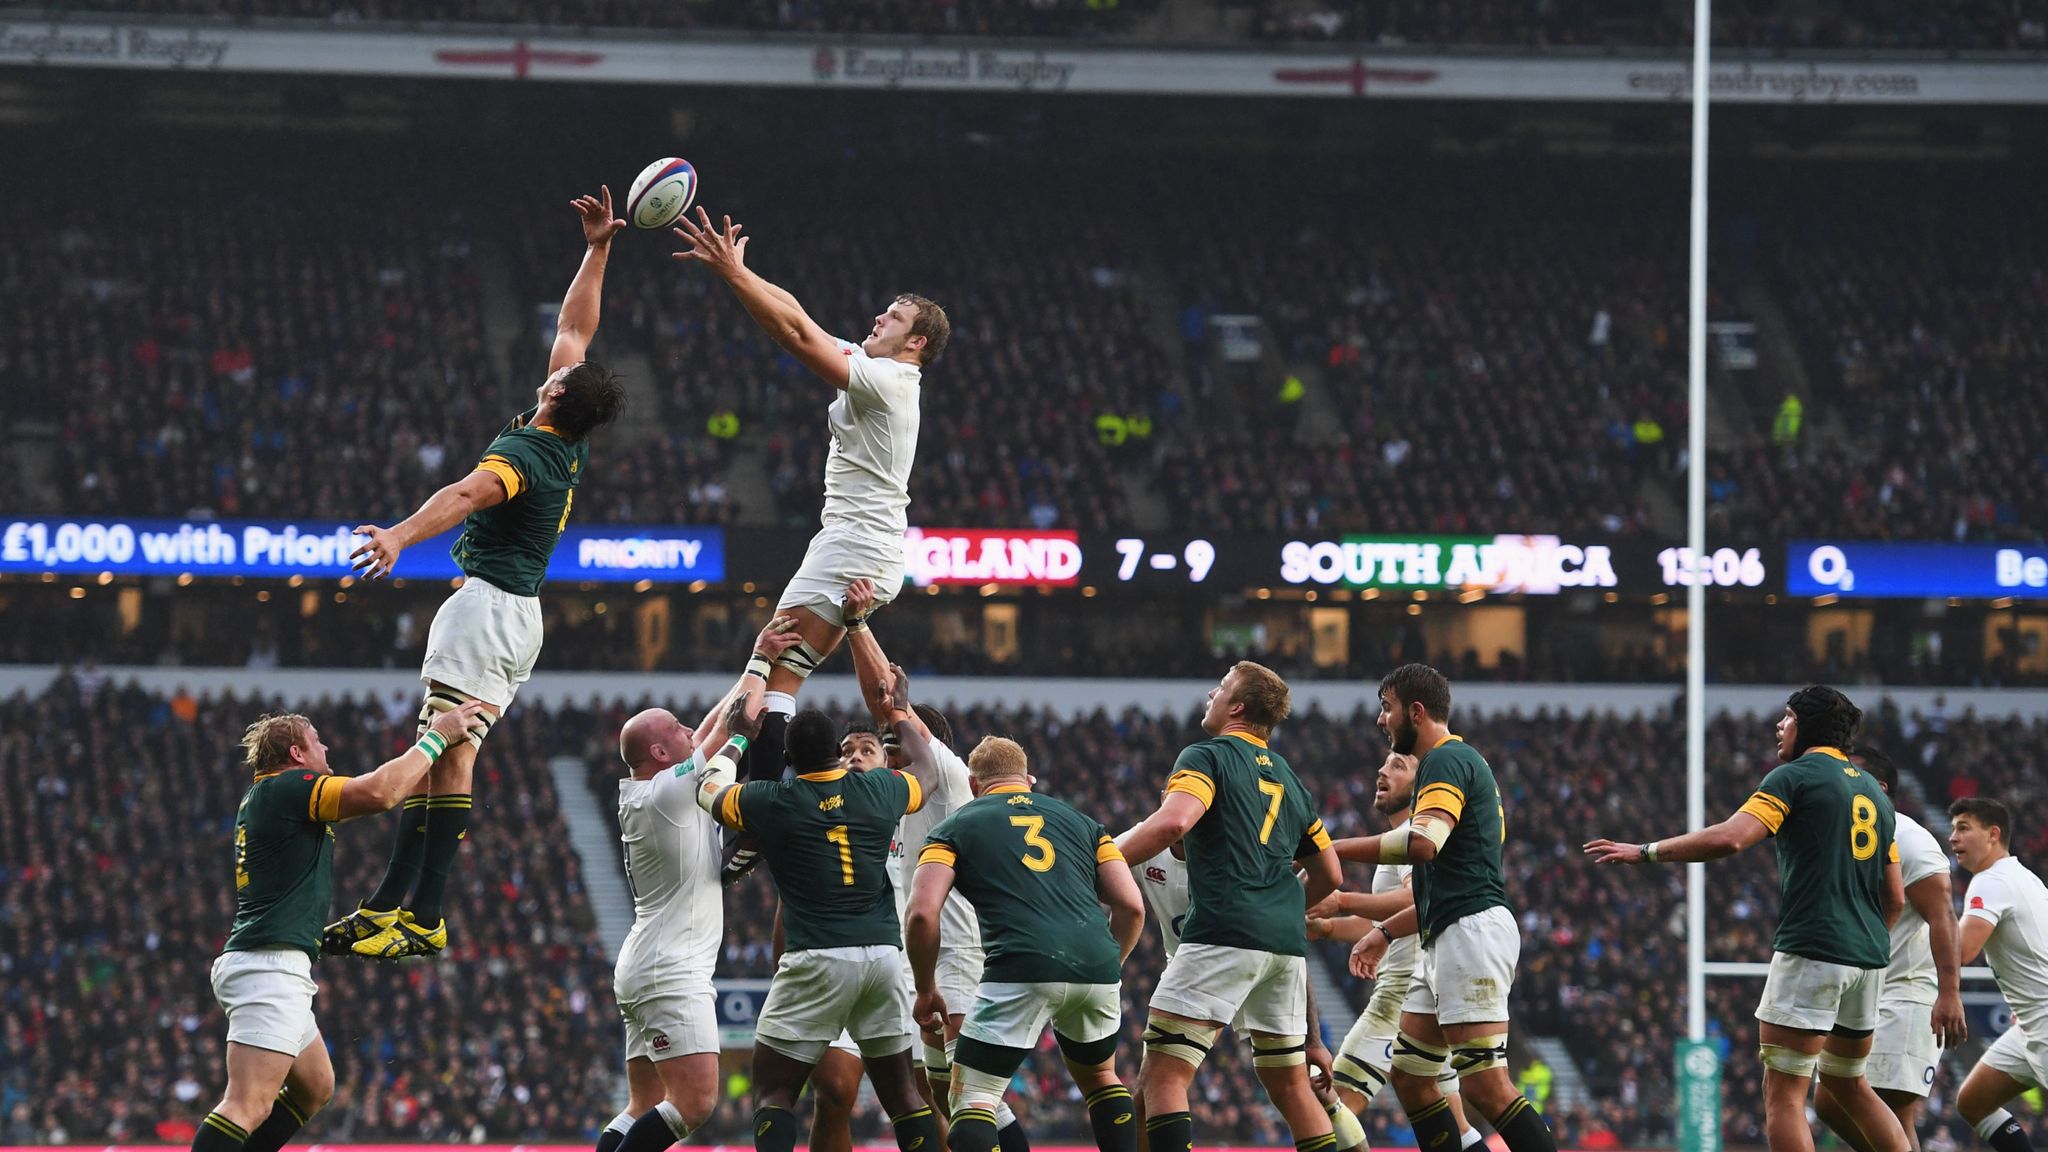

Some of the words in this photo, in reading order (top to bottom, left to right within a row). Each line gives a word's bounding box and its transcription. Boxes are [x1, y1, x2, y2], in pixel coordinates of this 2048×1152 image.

[0, 23, 119, 65] ngland
[126, 28, 230, 71] Rugby
[844, 47, 970, 90] England
[975, 48, 1076, 92] Rugby
[1626, 60, 1920, 101] englndrugby.com
[3, 521, 135, 566] £1,000
[140, 523, 236, 565] with
[578, 538, 702, 569] PRIORITY
[1281, 541, 1441, 584] SOUTH
[1258, 777, 1285, 845] 7
[1850, 794, 1878, 861] 8
[826, 824, 855, 886] 1
[1009, 815, 1056, 873] 3
